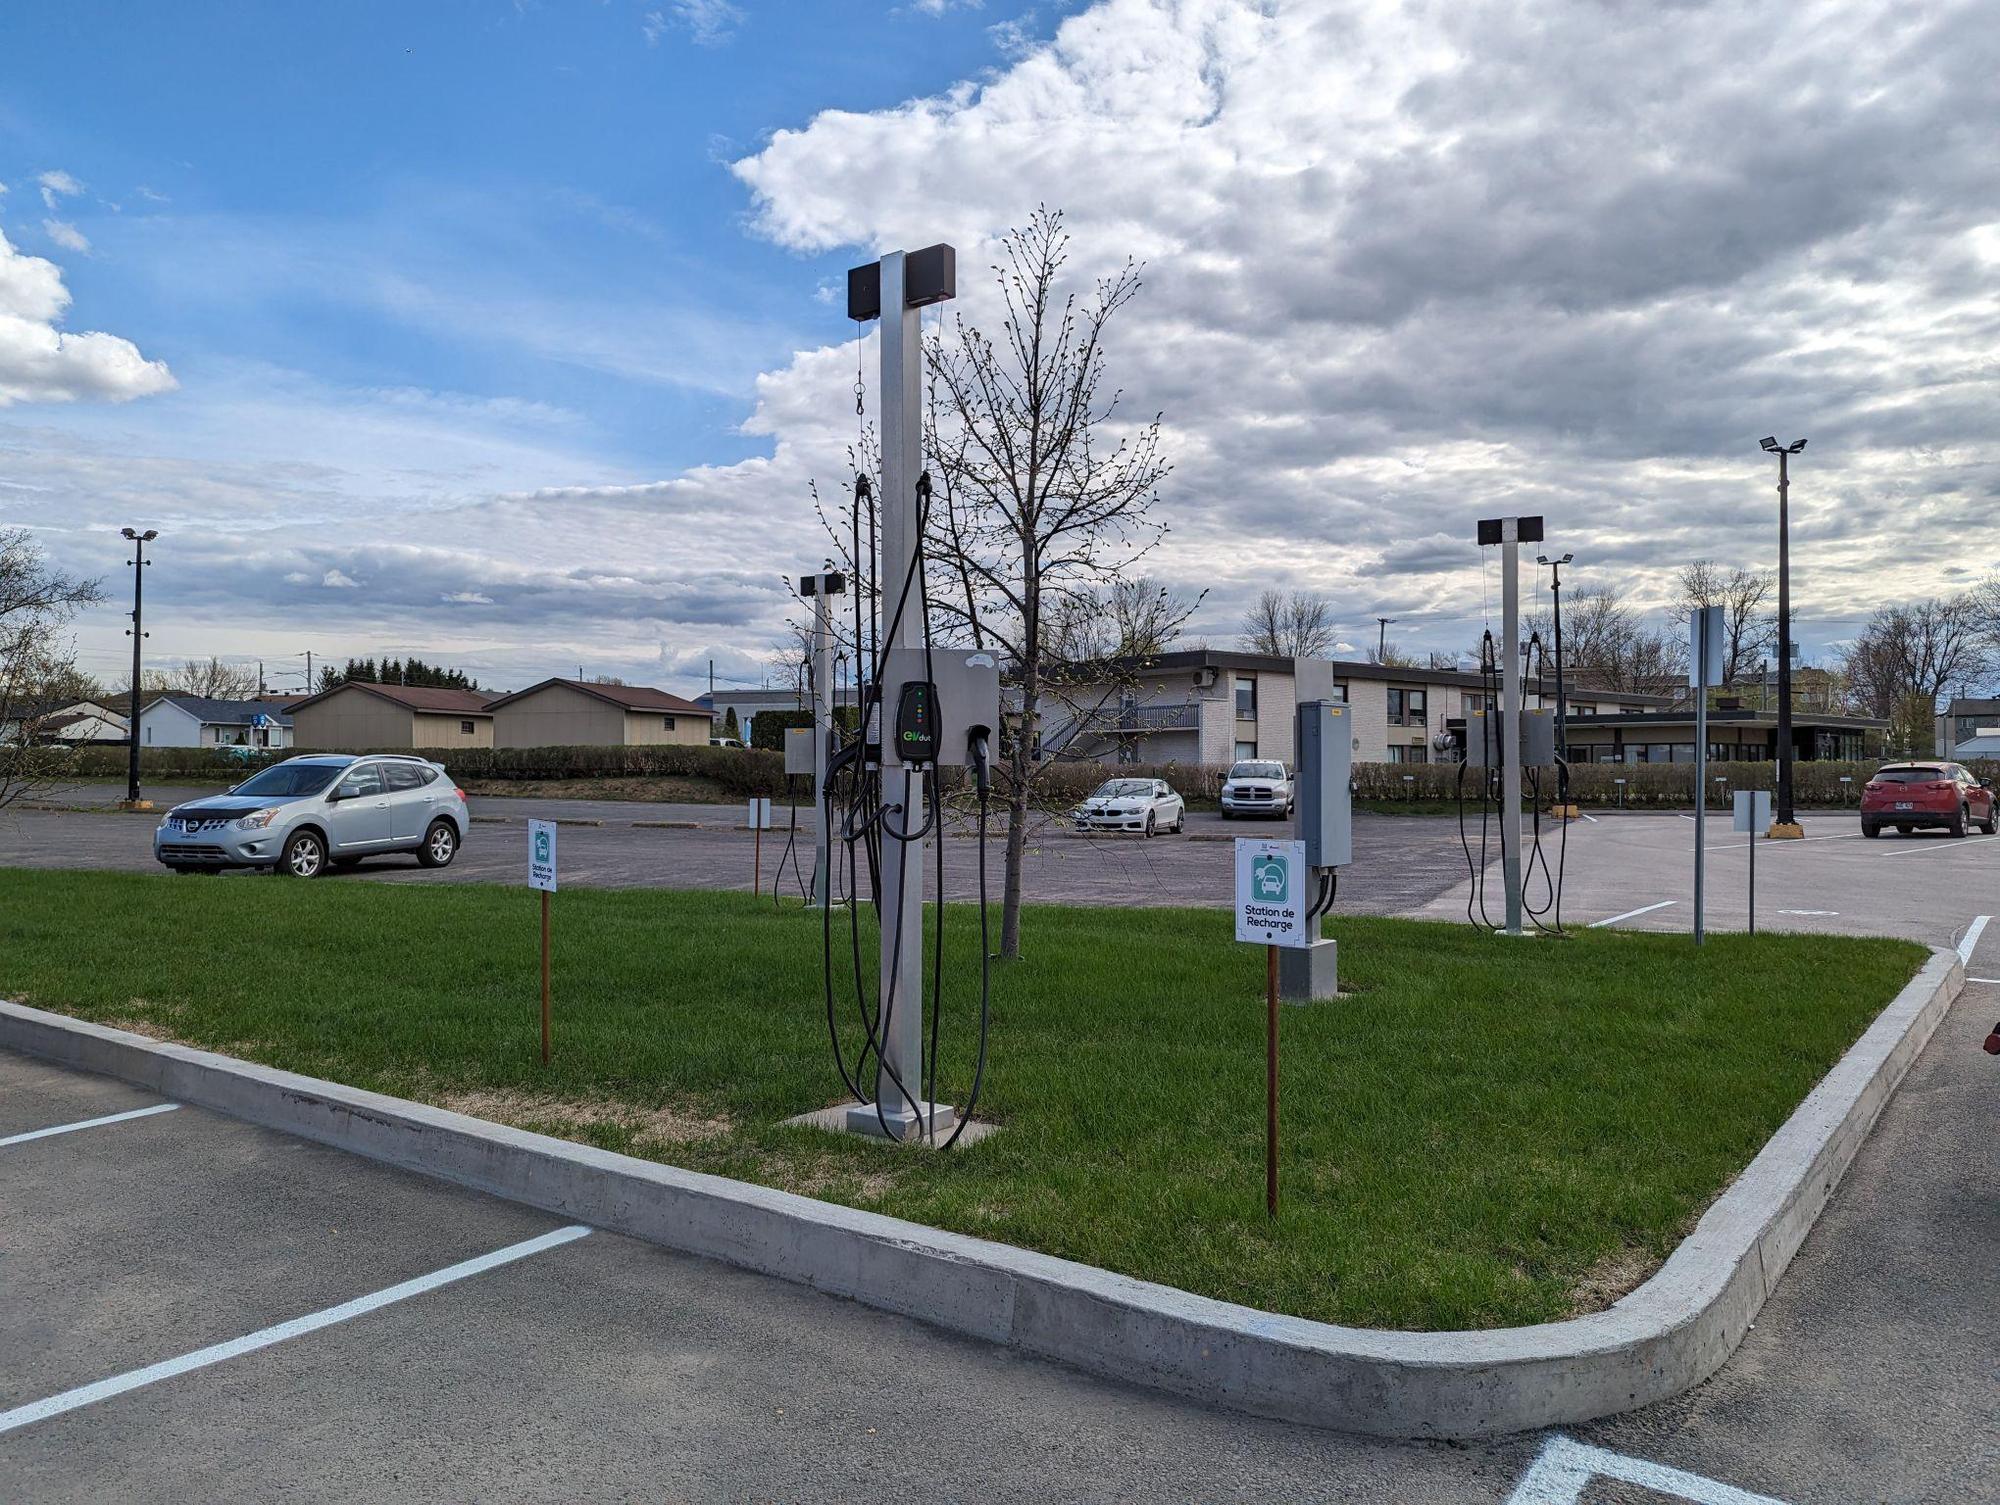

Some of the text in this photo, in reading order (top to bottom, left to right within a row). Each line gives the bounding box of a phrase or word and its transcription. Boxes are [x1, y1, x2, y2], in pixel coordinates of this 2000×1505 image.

[1245, 905, 1295, 918] Station de
[1247, 916, 1293, 932] Recharge
